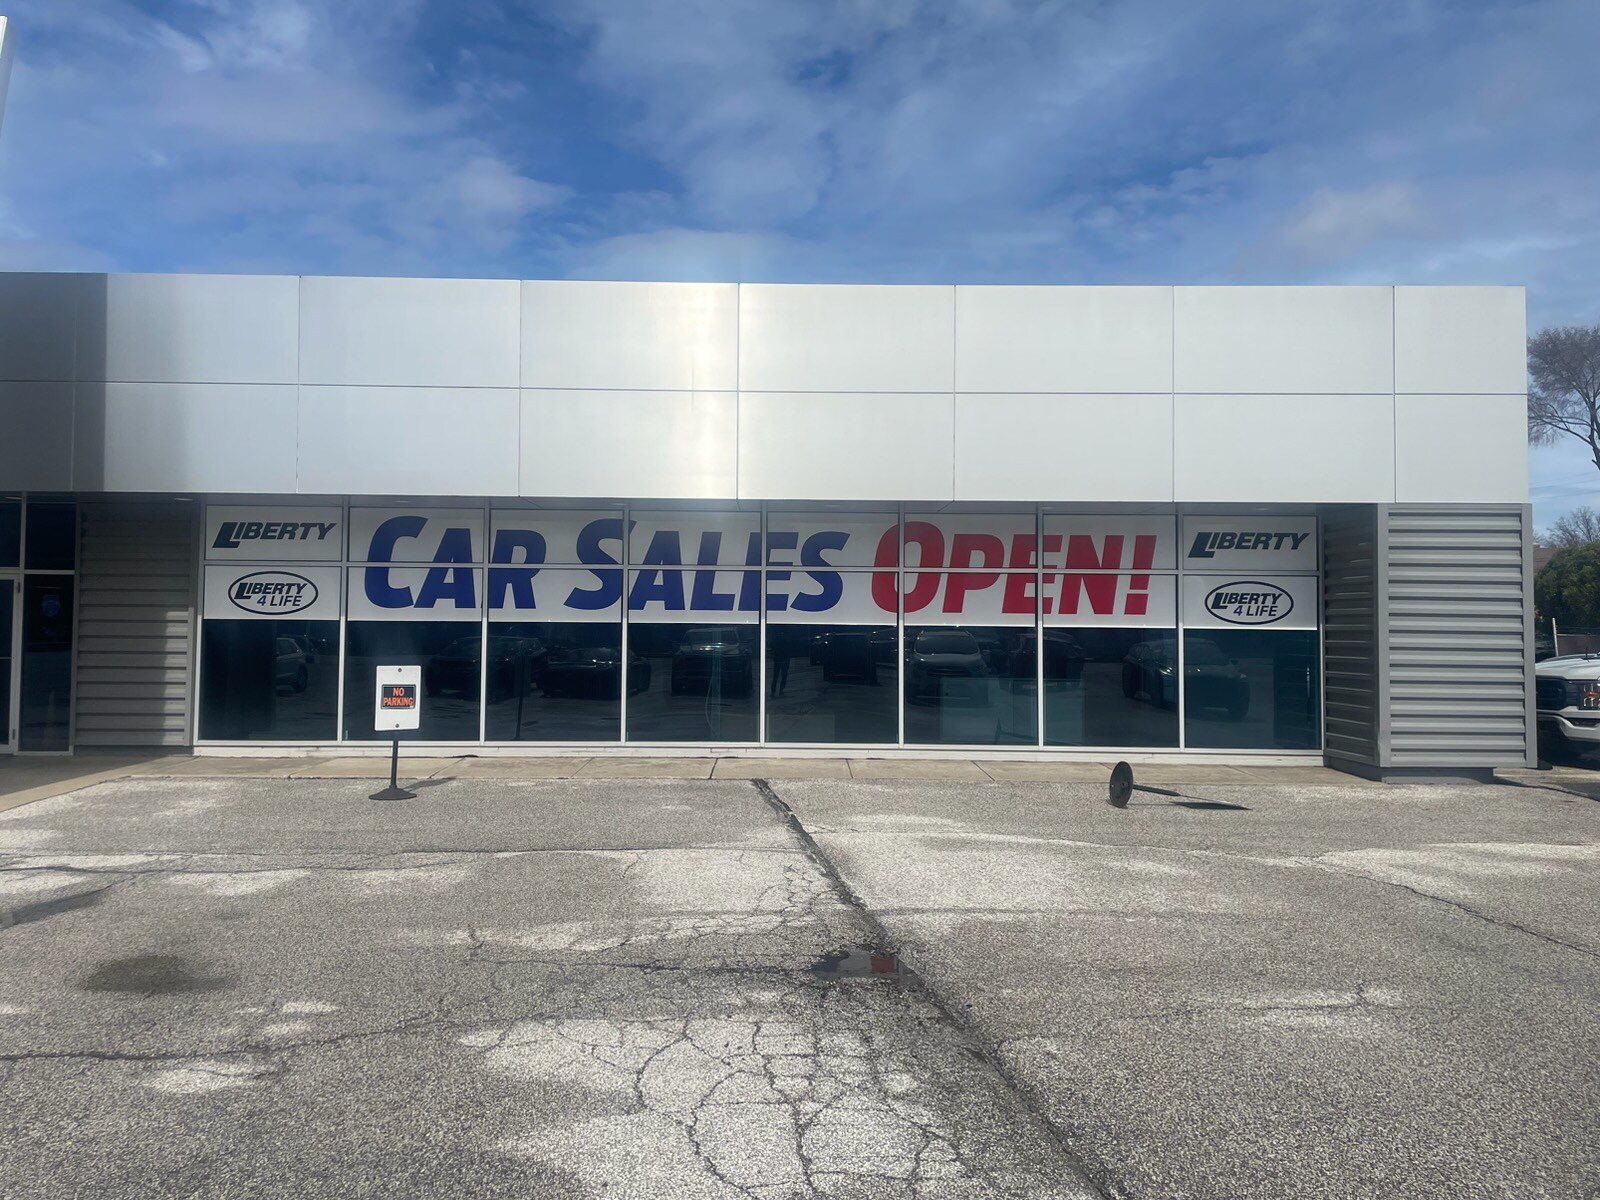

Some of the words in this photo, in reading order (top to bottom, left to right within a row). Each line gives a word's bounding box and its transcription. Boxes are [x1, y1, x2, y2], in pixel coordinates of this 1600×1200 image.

[212, 522, 337, 548] LIBERTY
[1187, 531, 1310, 558] LIBERTY
[364, 515, 547, 610] CAR
[563, 517, 850, 613] SALES
[871, 521, 1157, 615] OPEN!
[234, 582, 308, 600] LIBERTY
[256, 595, 267, 607] 4
[269, 595, 303, 607] LIFE
[1210, 592, 1283, 610] LIBERTY
[1233, 604, 1244, 617] 4
[1246, 605, 1278, 617] LIFE
[392, 687, 405, 697] NO
[383, 697, 414, 706] PARKING
